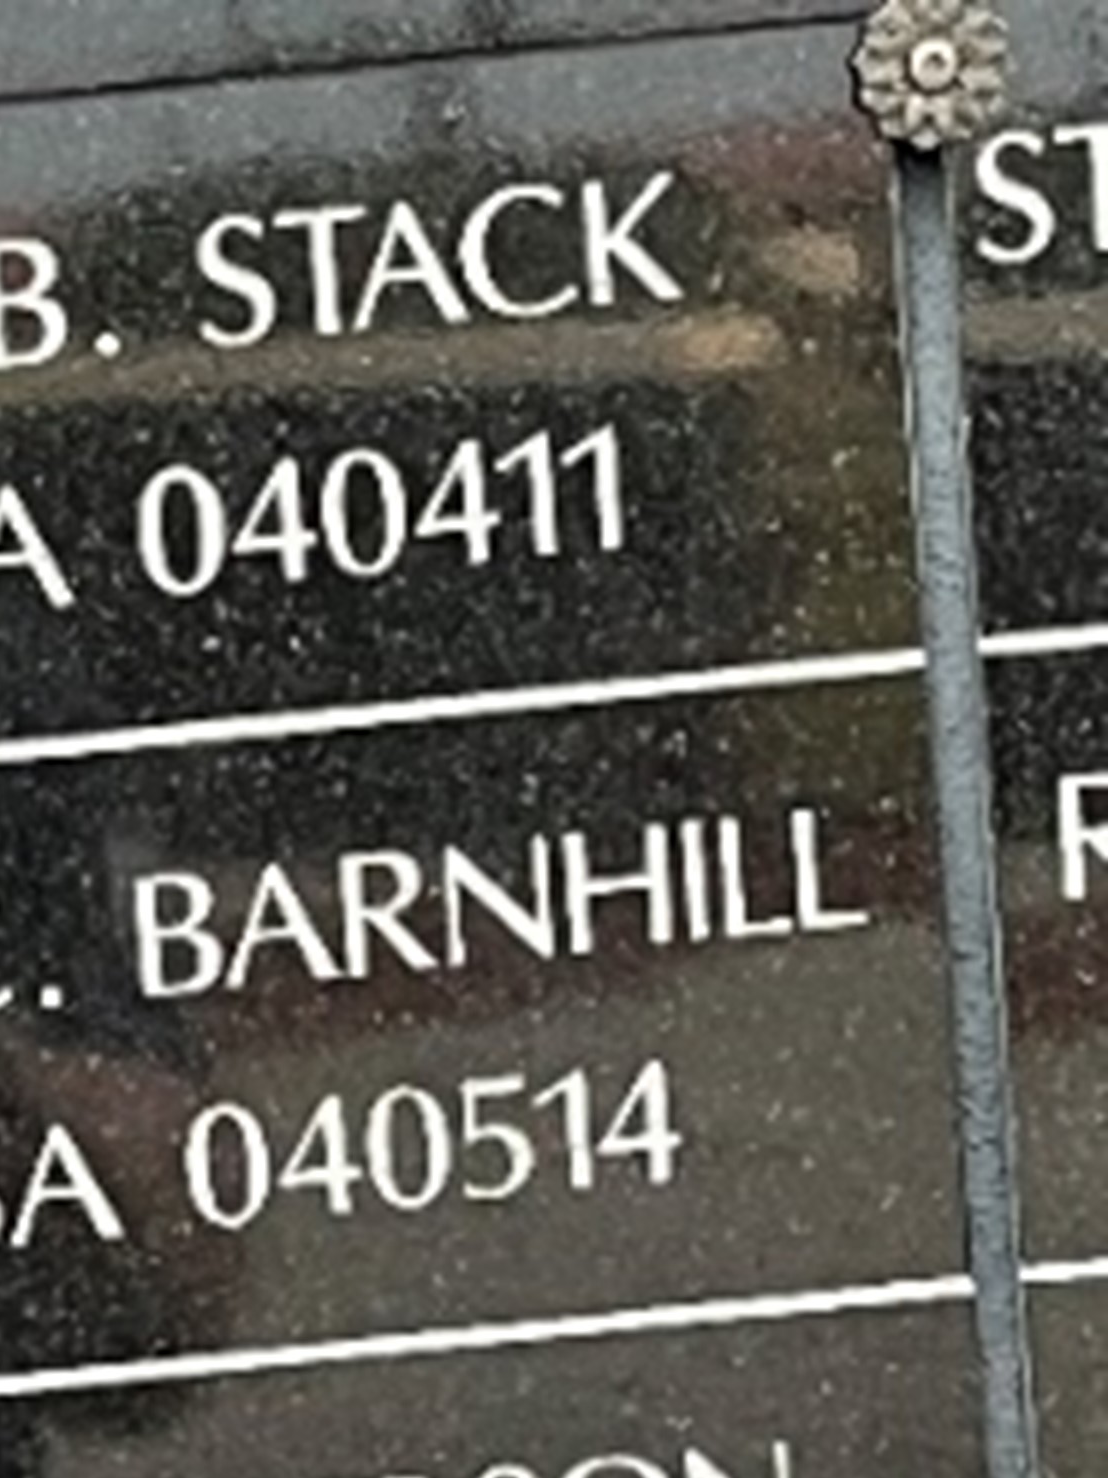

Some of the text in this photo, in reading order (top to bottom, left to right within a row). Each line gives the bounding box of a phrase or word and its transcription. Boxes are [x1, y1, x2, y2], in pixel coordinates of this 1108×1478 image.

[196, 171, 683, 348] STACK
[138, 425, 623, 597] 040411
[133, 808, 869, 998] BARNHILL
[183, 1058, 683, 1230] 040514
